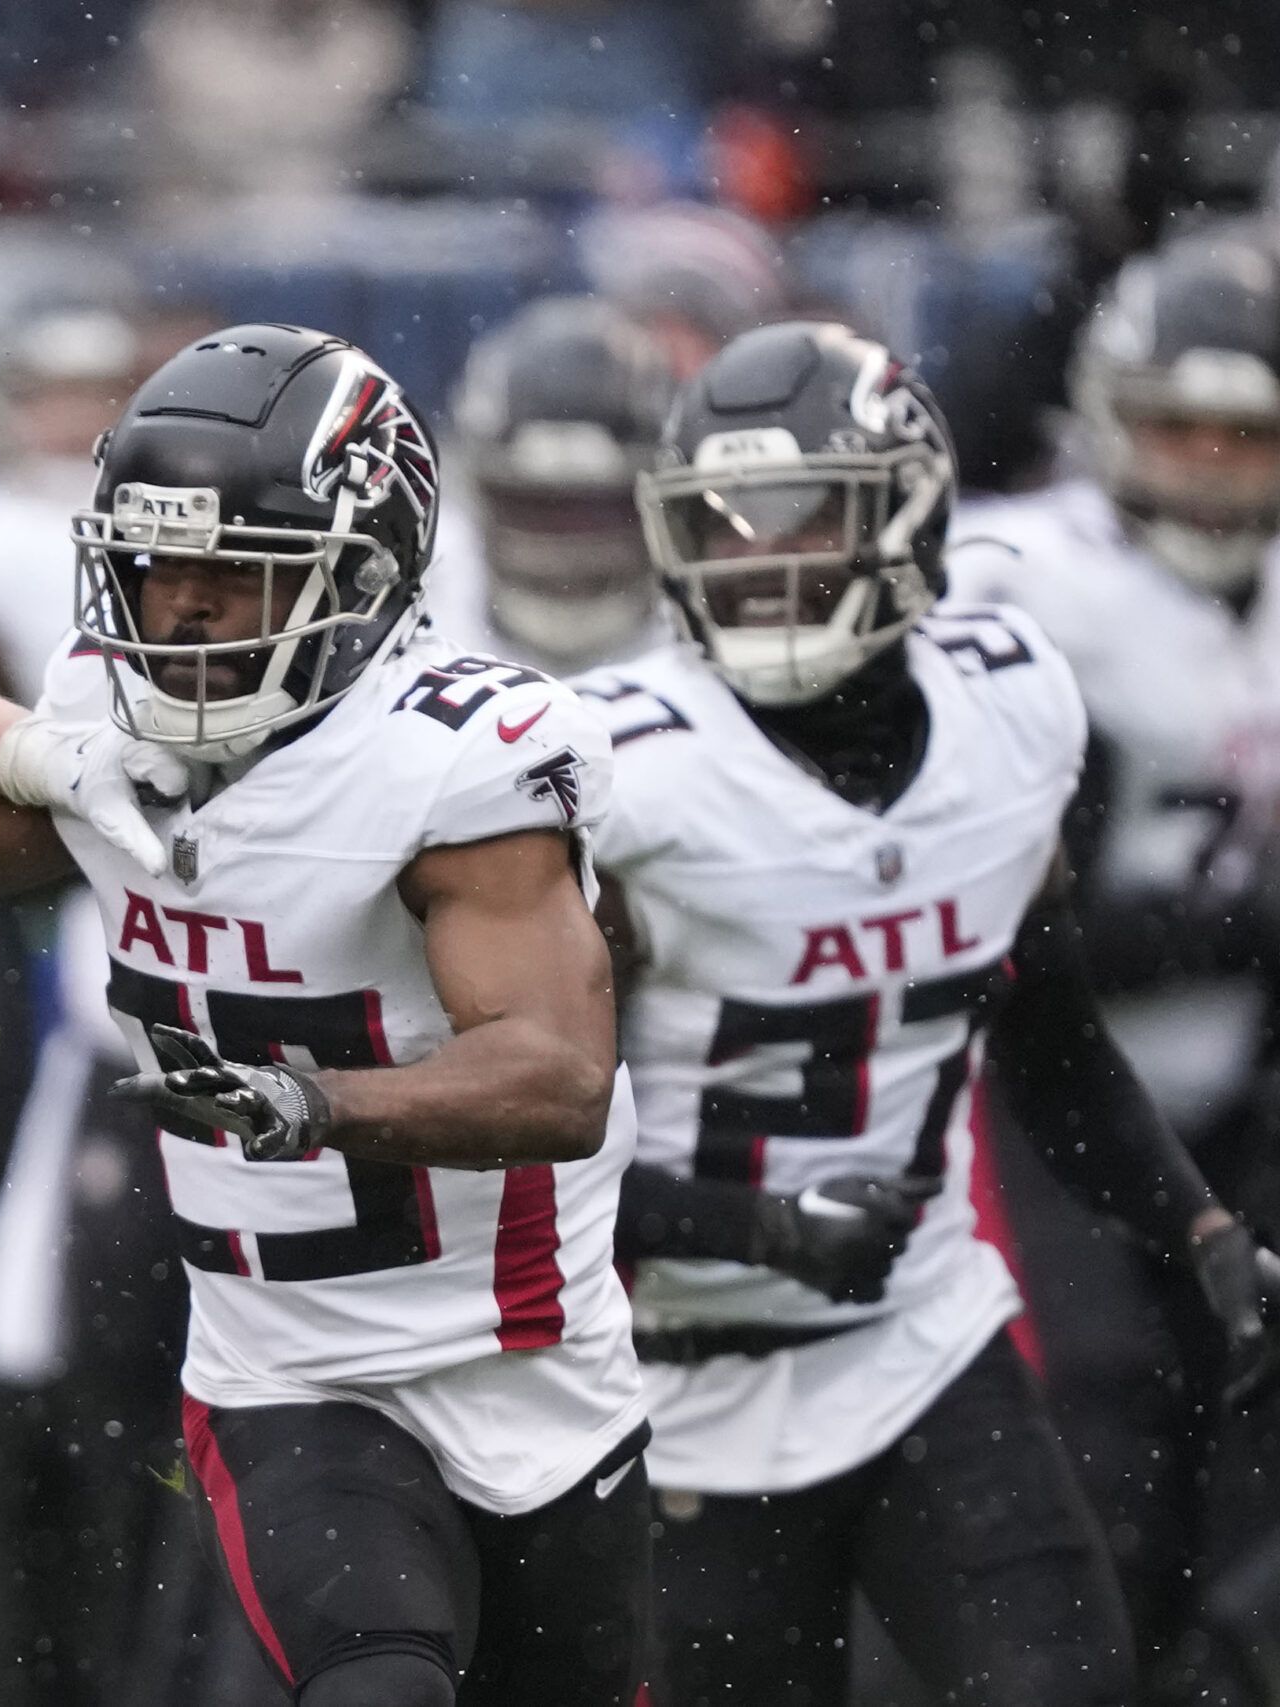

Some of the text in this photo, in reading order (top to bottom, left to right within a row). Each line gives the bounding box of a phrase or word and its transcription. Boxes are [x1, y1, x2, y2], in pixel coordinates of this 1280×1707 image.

[143, 499, 188, 517] ATL
[388, 655, 551, 732] 29
[120, 887, 302, 983] ATL
[790, 899, 981, 985] ATL
[692, 955, 1018, 1225] 27
